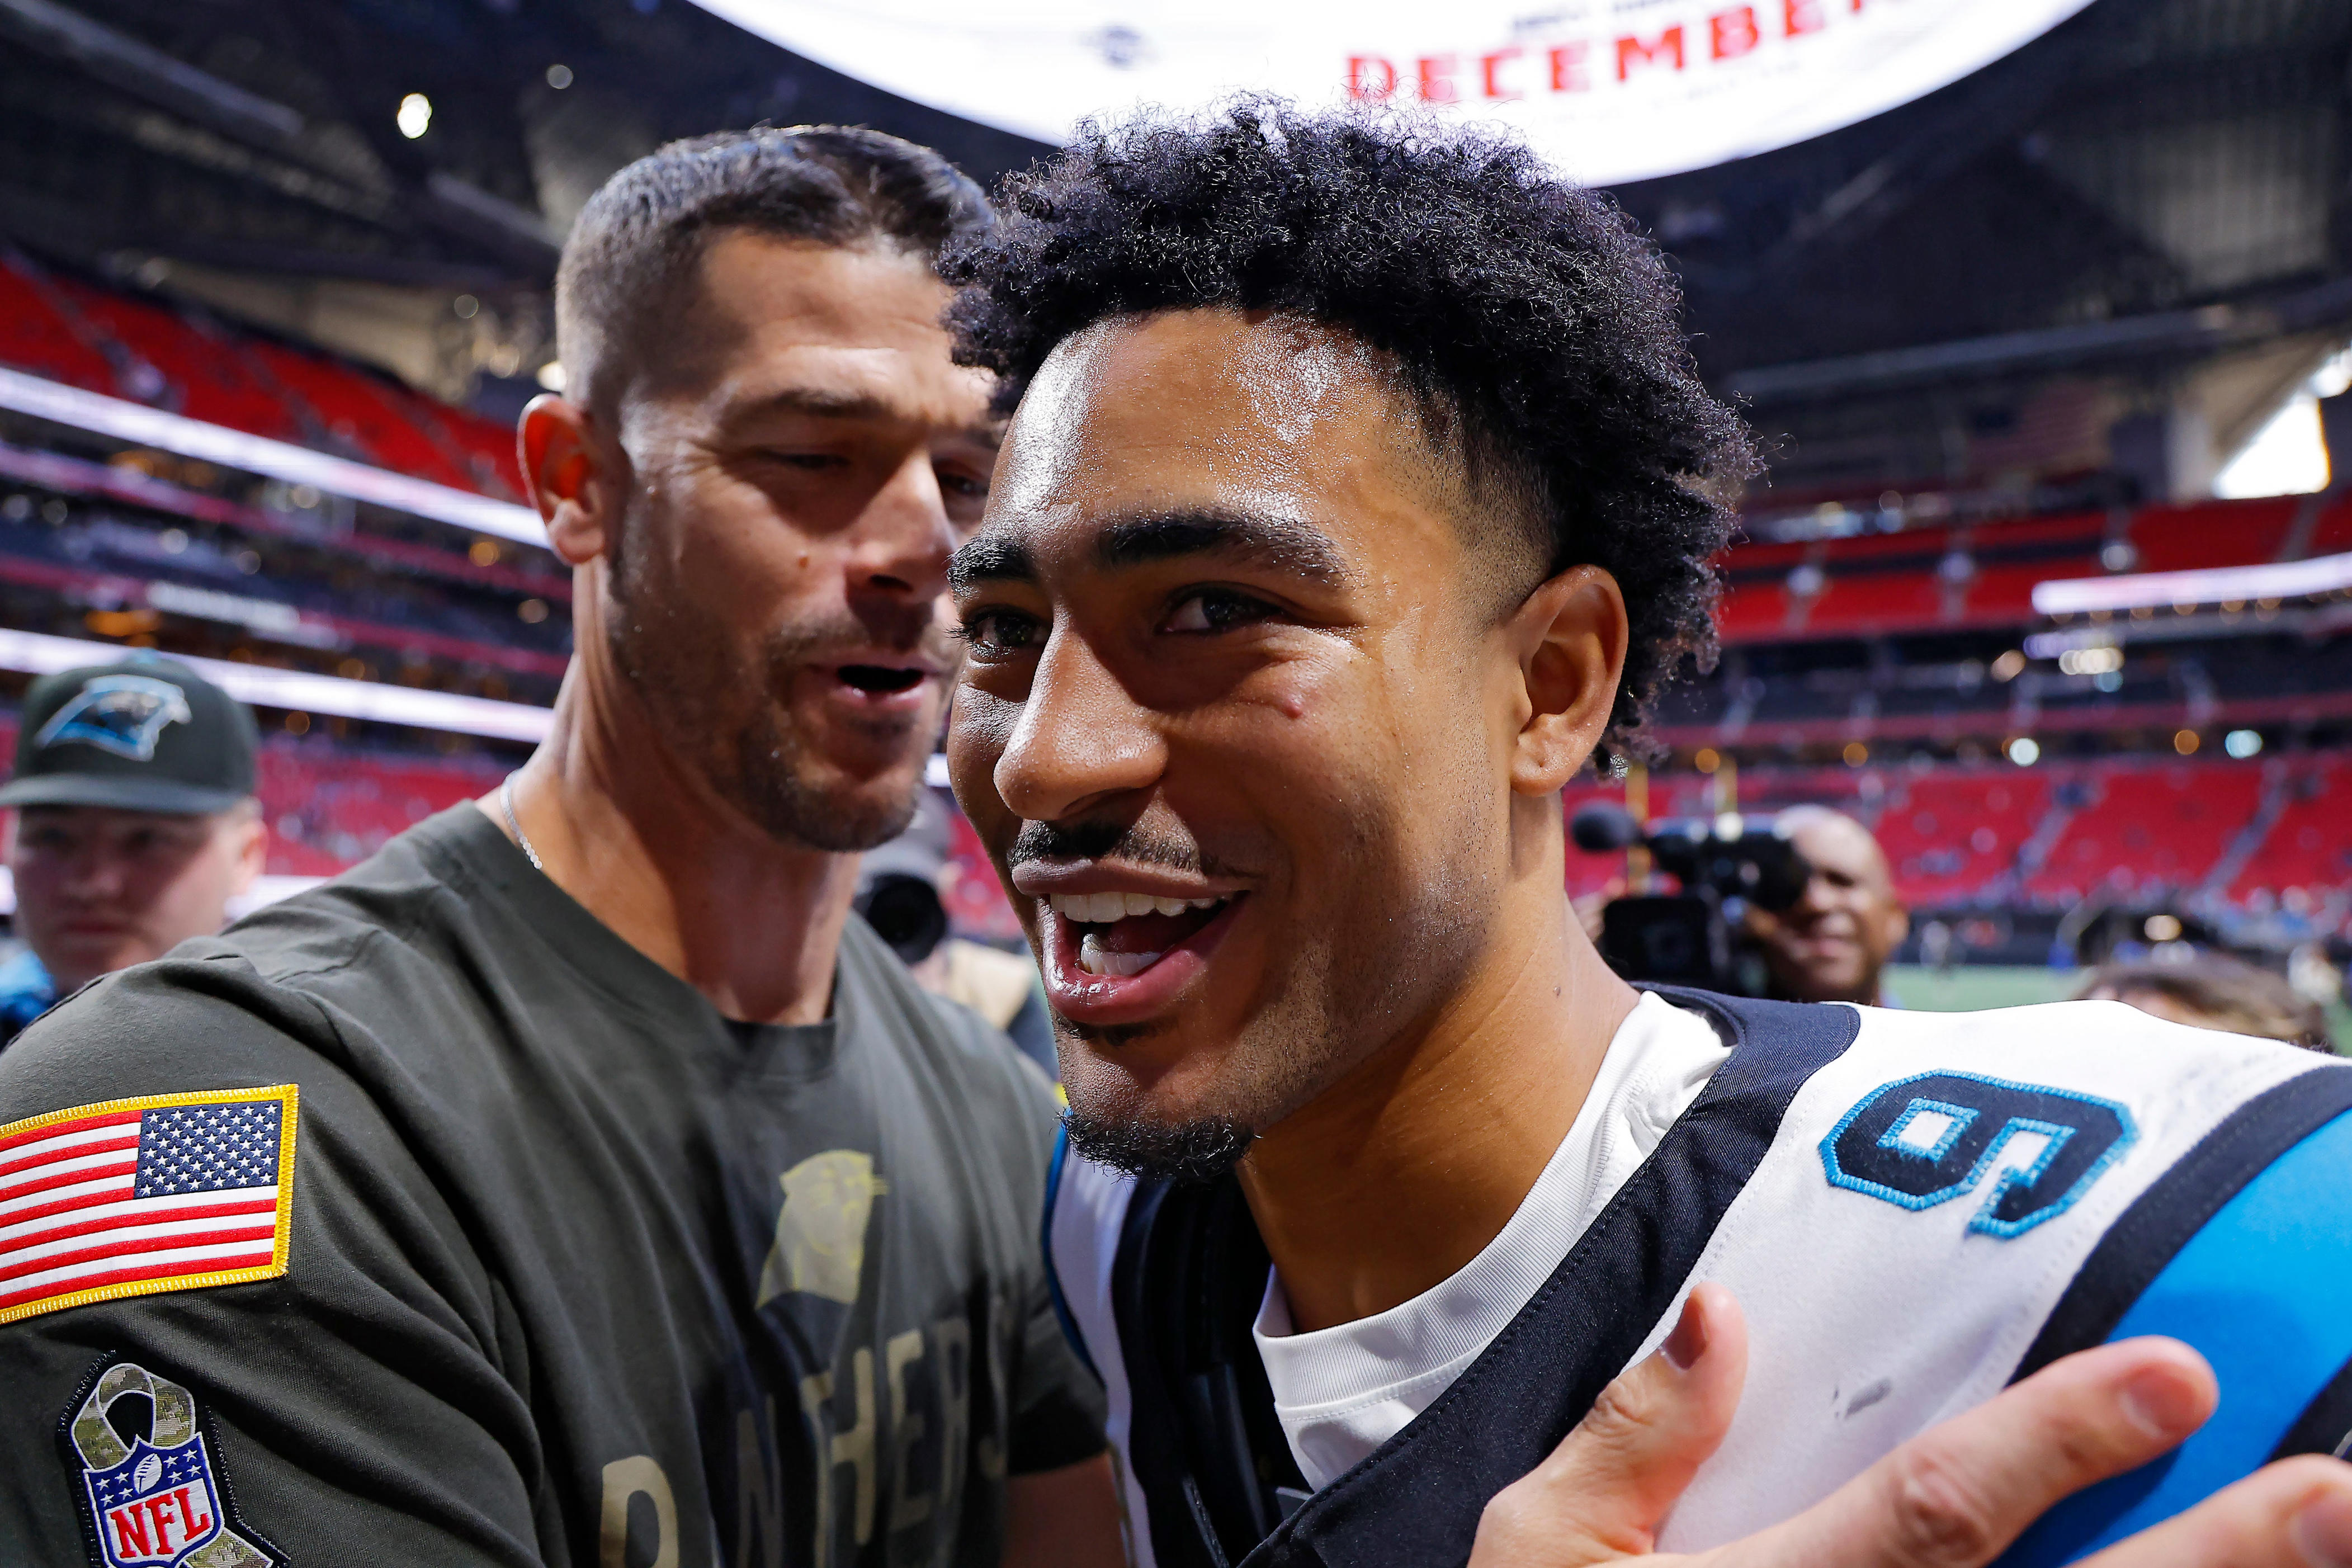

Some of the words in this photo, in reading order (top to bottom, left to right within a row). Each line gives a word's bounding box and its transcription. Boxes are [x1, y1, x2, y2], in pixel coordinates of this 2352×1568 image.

[1347, 0, 1863, 102] DECEMBE
[1818, 1068, 2141, 1240] 9
[599, 1314, 1009, 1568] PNTHER
[110, 1487, 211, 1558] NFL
